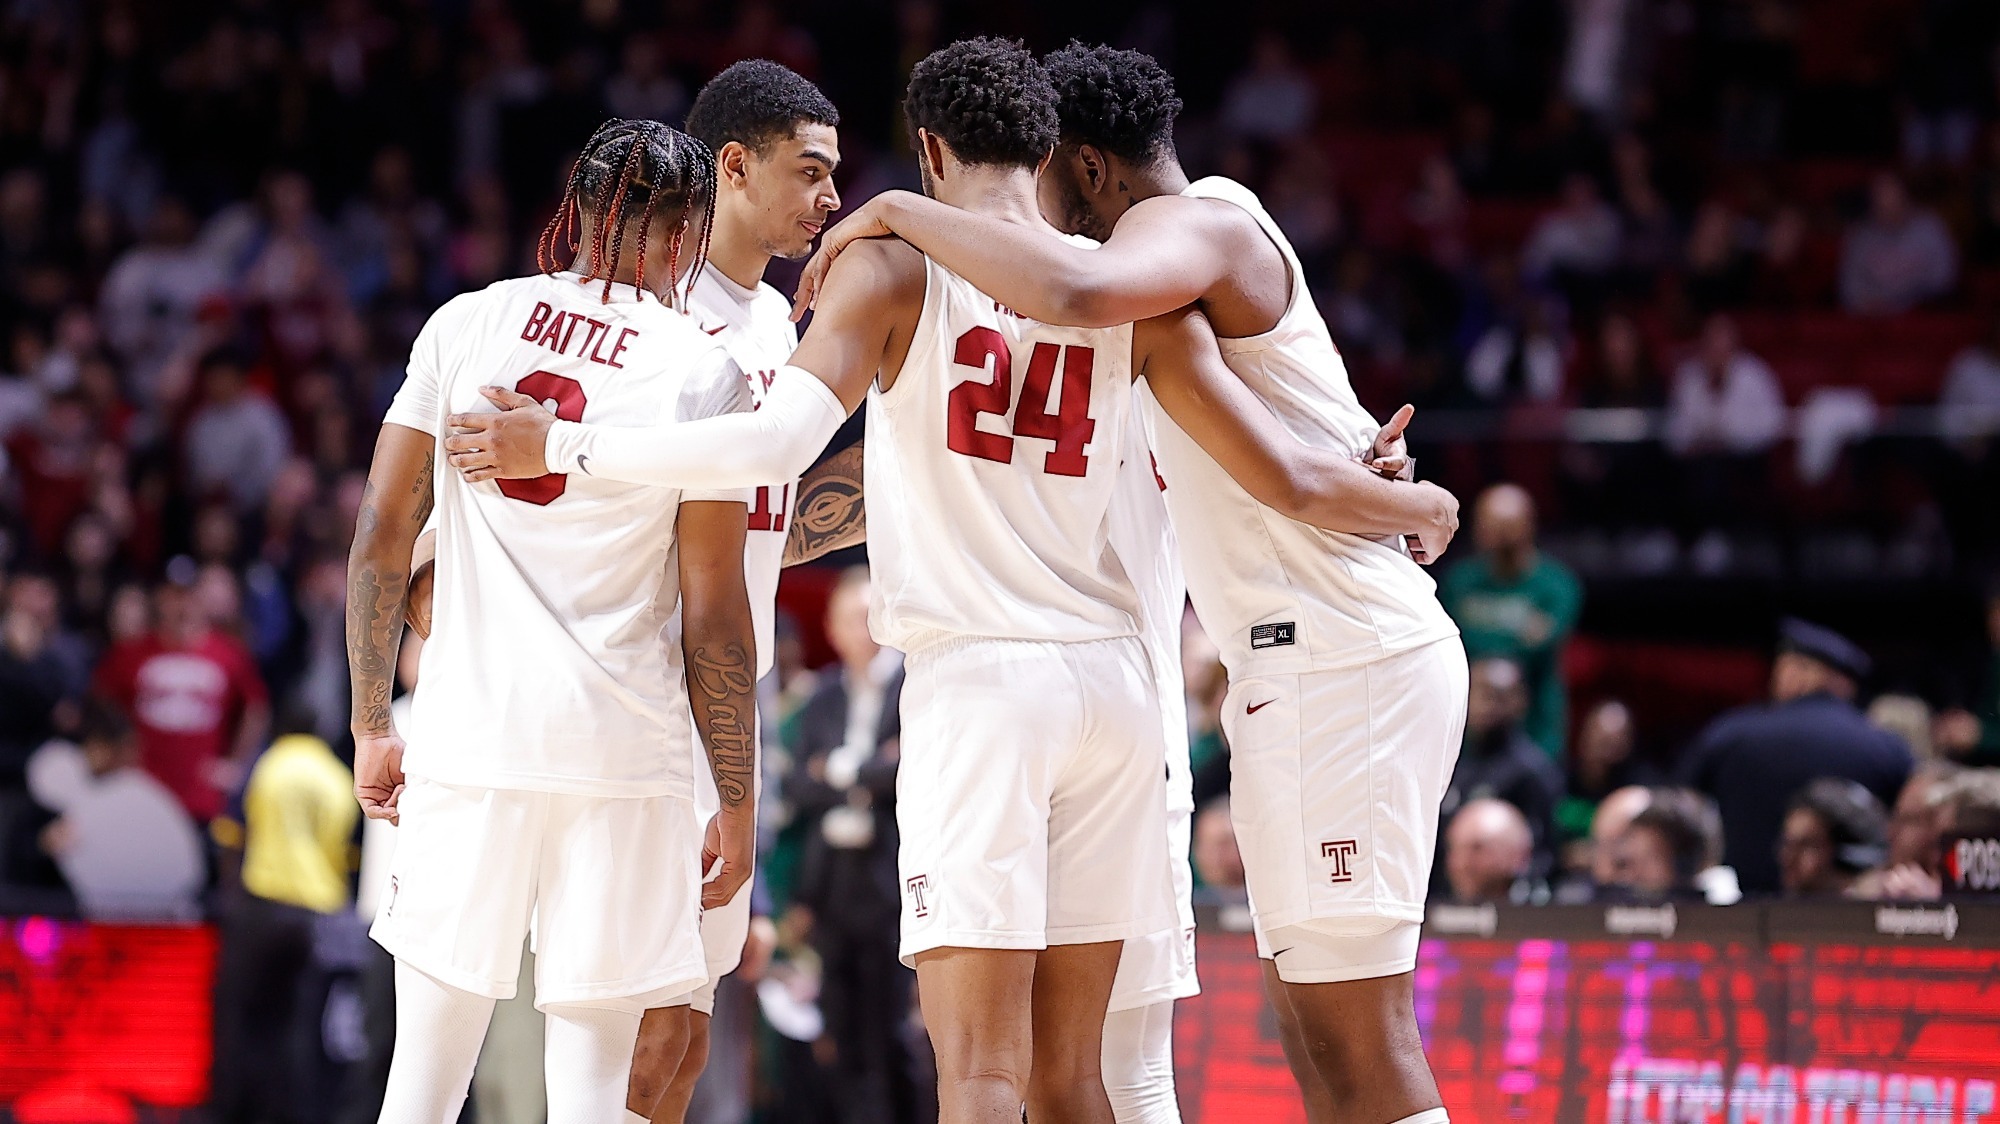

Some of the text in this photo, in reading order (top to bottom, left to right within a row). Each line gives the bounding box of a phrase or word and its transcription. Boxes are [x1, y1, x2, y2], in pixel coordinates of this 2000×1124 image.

[520, 301, 639, 369] BATTLE
[947, 325, 1096, 477] 24
[1278, 628, 1290, 639] XL
[693, 643, 753, 807] Battle
